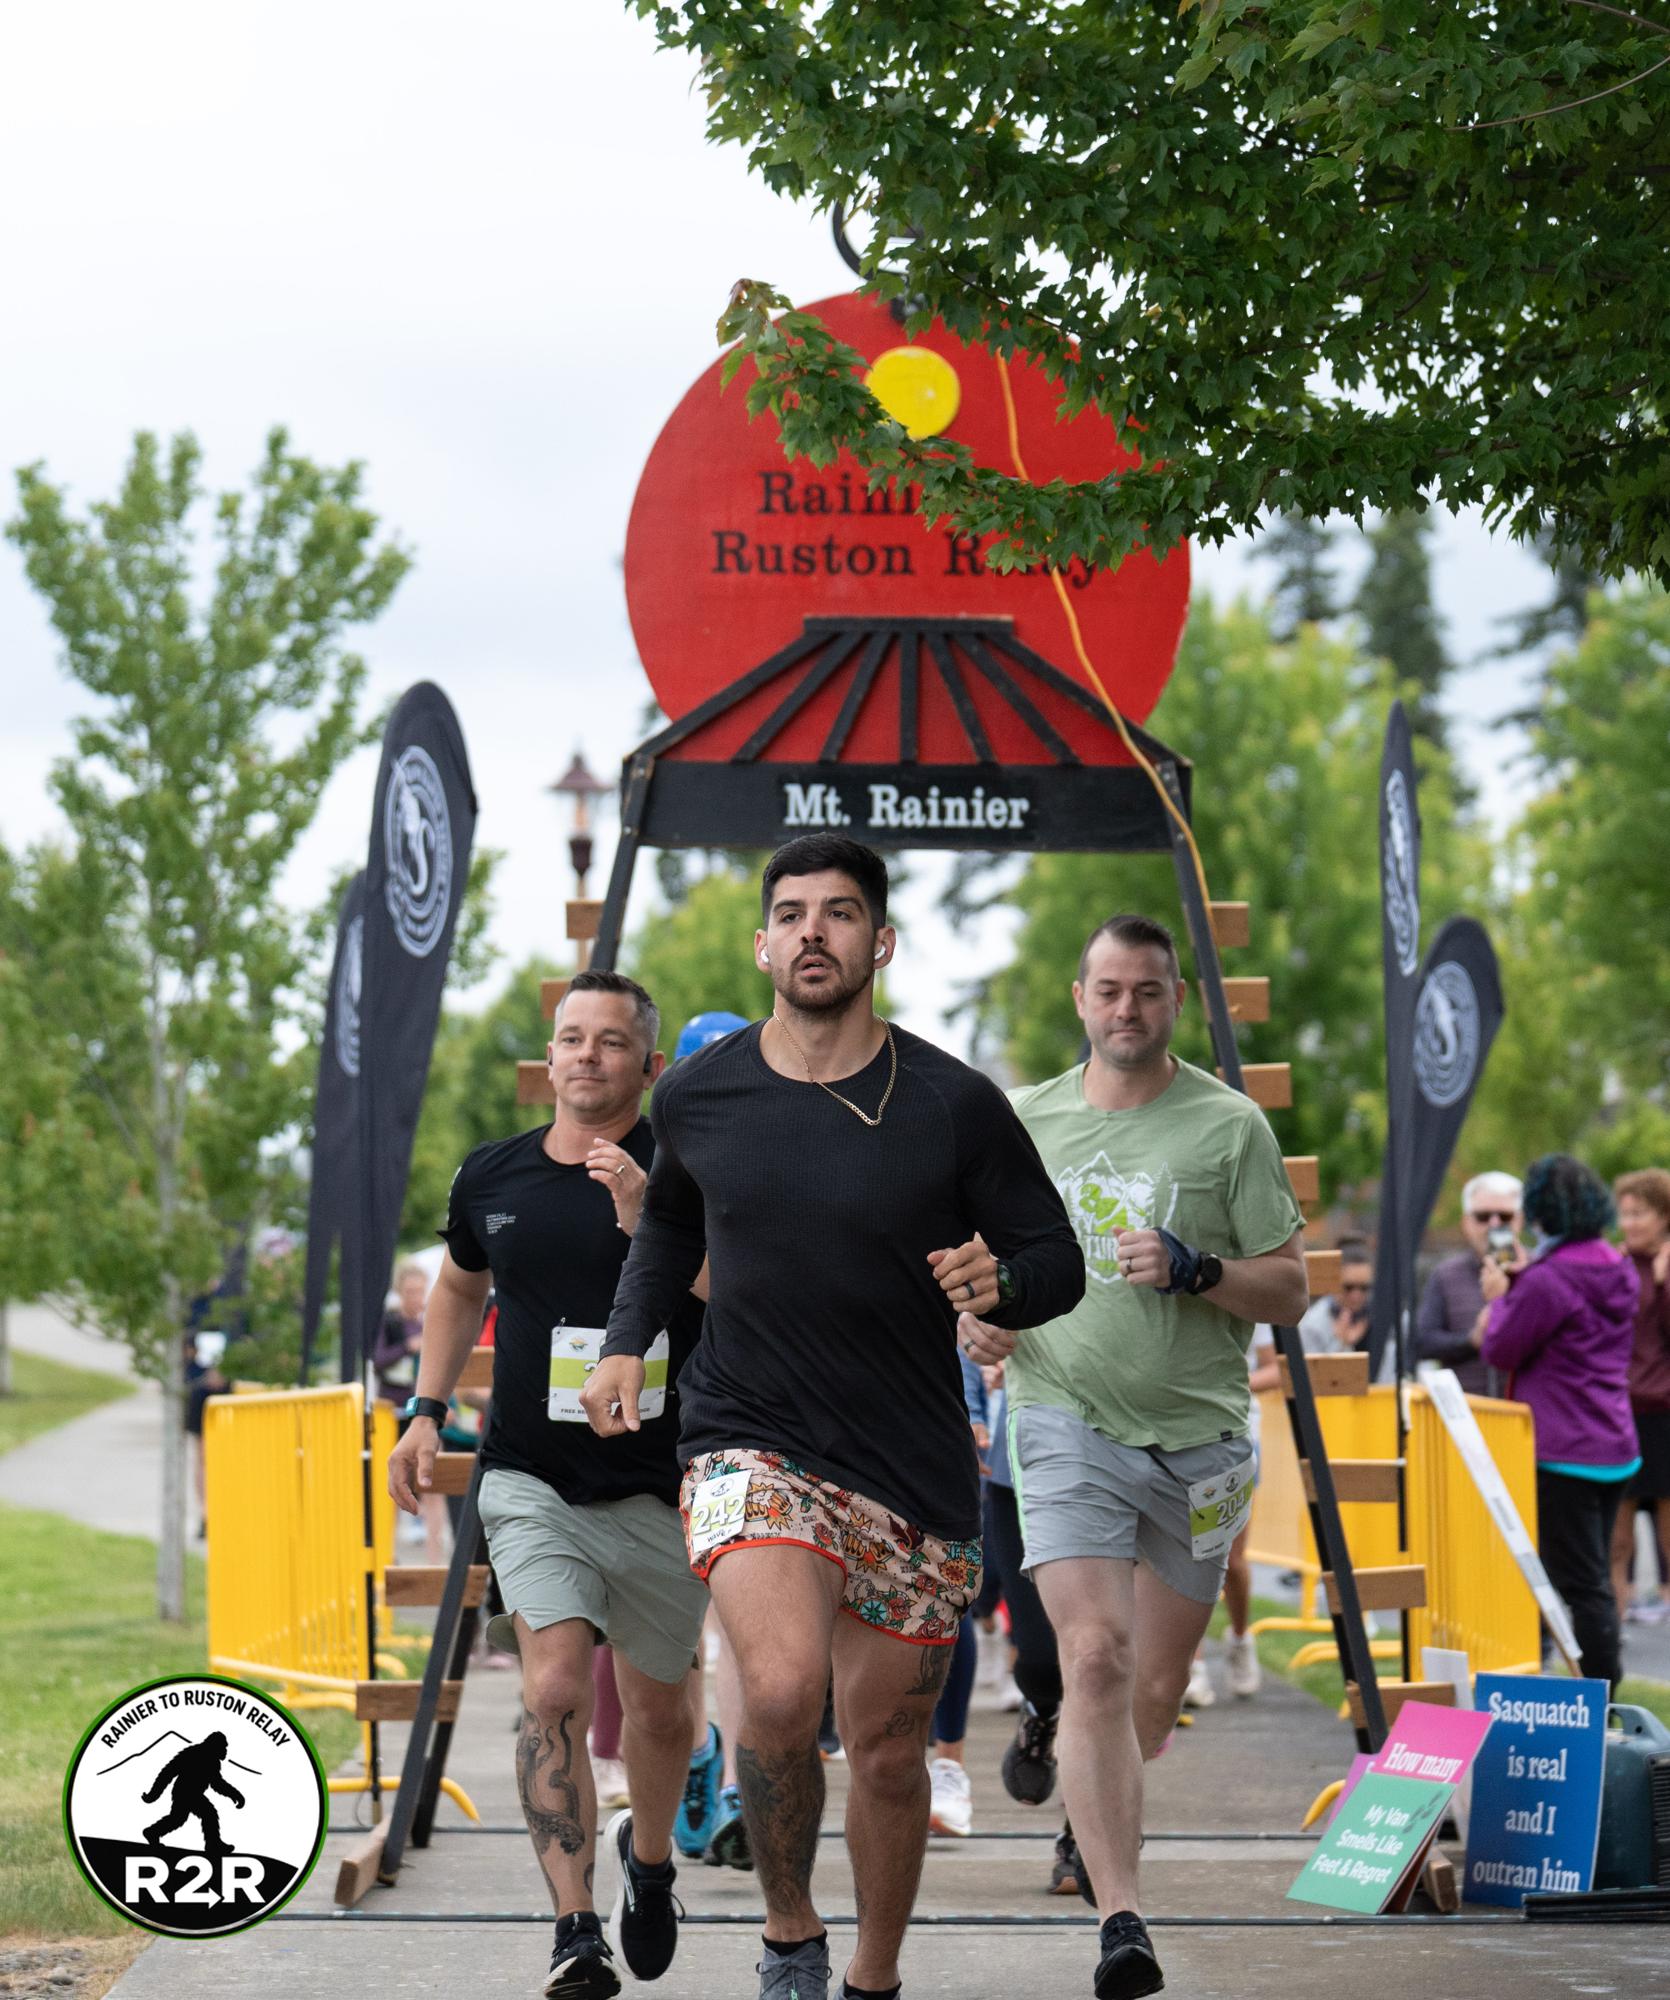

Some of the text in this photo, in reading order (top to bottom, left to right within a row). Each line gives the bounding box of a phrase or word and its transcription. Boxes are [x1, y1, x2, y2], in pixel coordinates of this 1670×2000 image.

[711, 531, 915, 576] Ruston
[783, 783, 1030, 828] Mt. Rainier
[693, 1495, 745, 1536] 242
[1488, 1692, 1590, 1734] Sasquatch
[1383, 1742, 1464, 1784] How many
[1506, 1745, 1568, 1782] is real
[1363, 1804, 1411, 1827] My Van
[1505, 1801, 1558, 1836] and I
[1335, 1829, 1405, 1856] Smells Like
[1311, 1853, 1343, 1875] Feet
[1348, 1860, 1393, 1886] Regret
[1472, 1857, 1581, 1892] outran him
